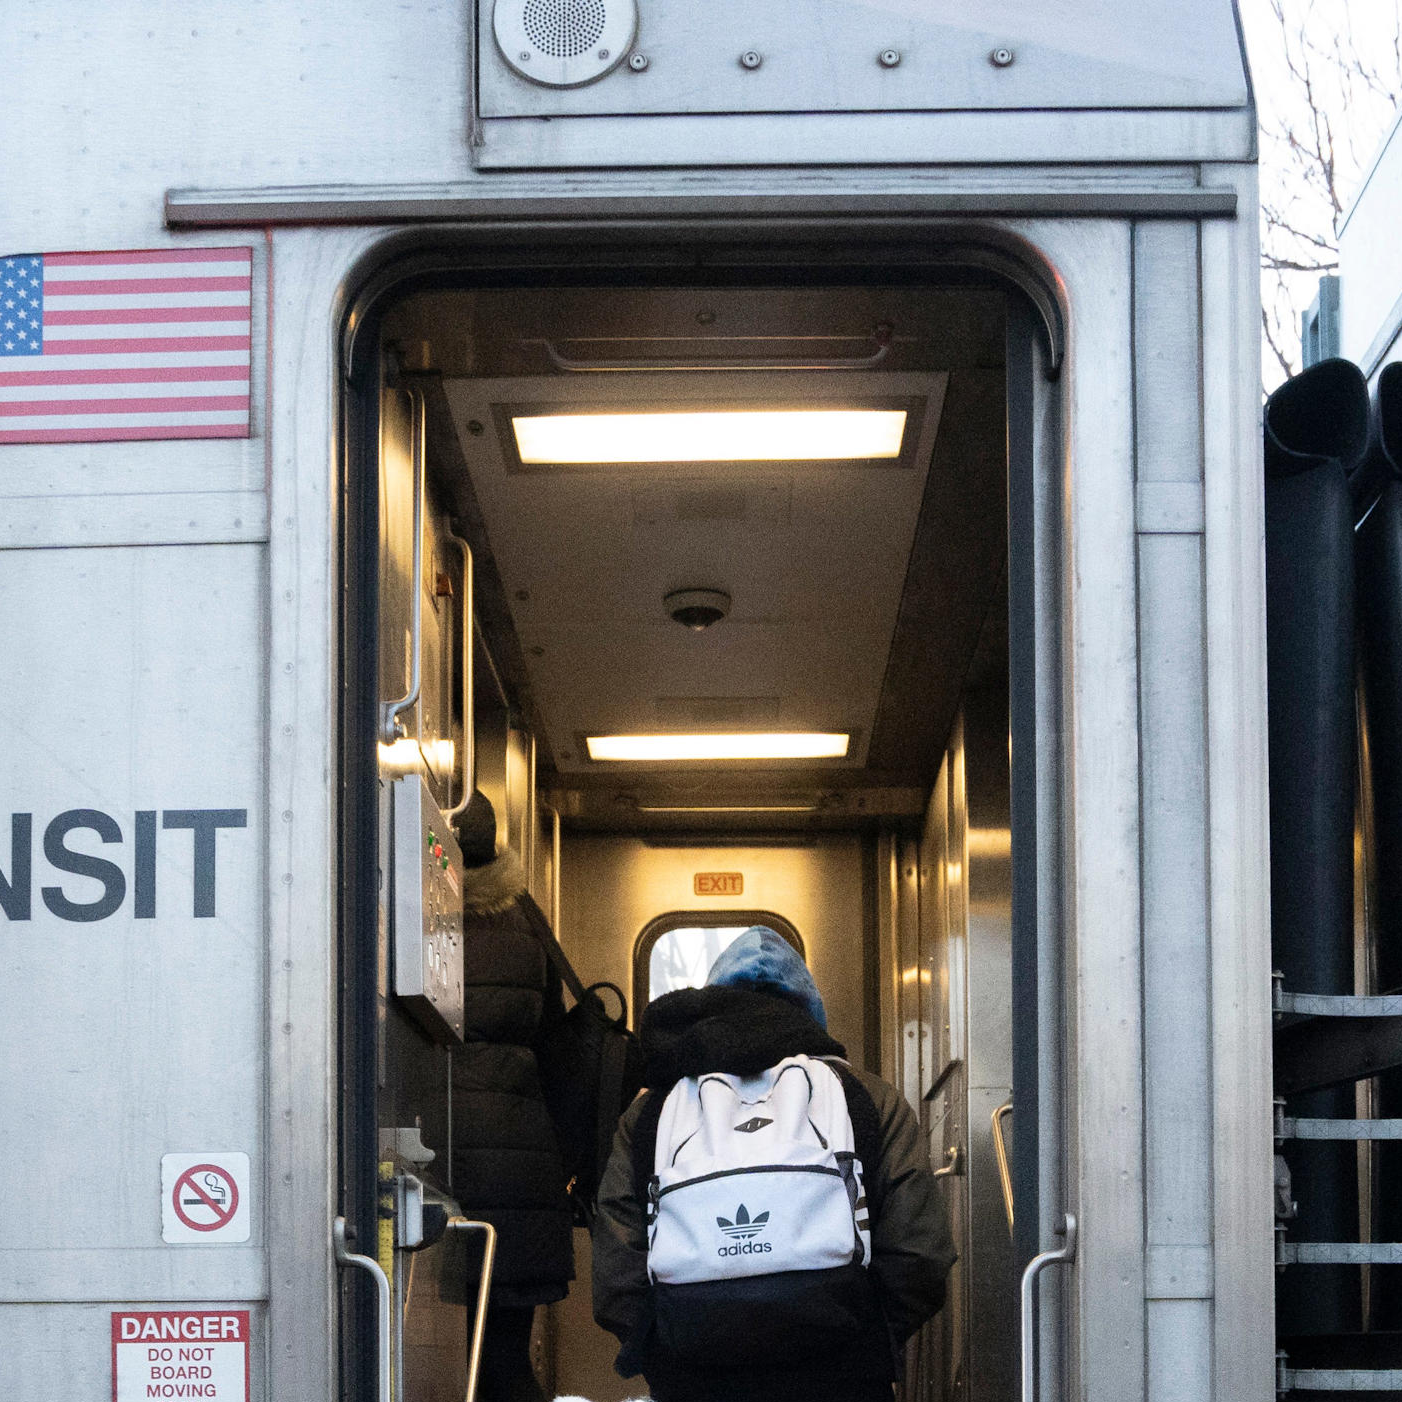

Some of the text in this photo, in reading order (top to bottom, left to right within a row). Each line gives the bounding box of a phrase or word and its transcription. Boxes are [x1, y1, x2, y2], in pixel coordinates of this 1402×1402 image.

[698, 876, 740, 891] EXIT
[718, 1241, 772, 1257] adidas
[121, 1317, 240, 1340] DANGER
[148, 1348, 214, 1361] DO NOT
[150, 1366, 212, 1380] BOARD
[147, 1384, 216, 1397] MOVING
